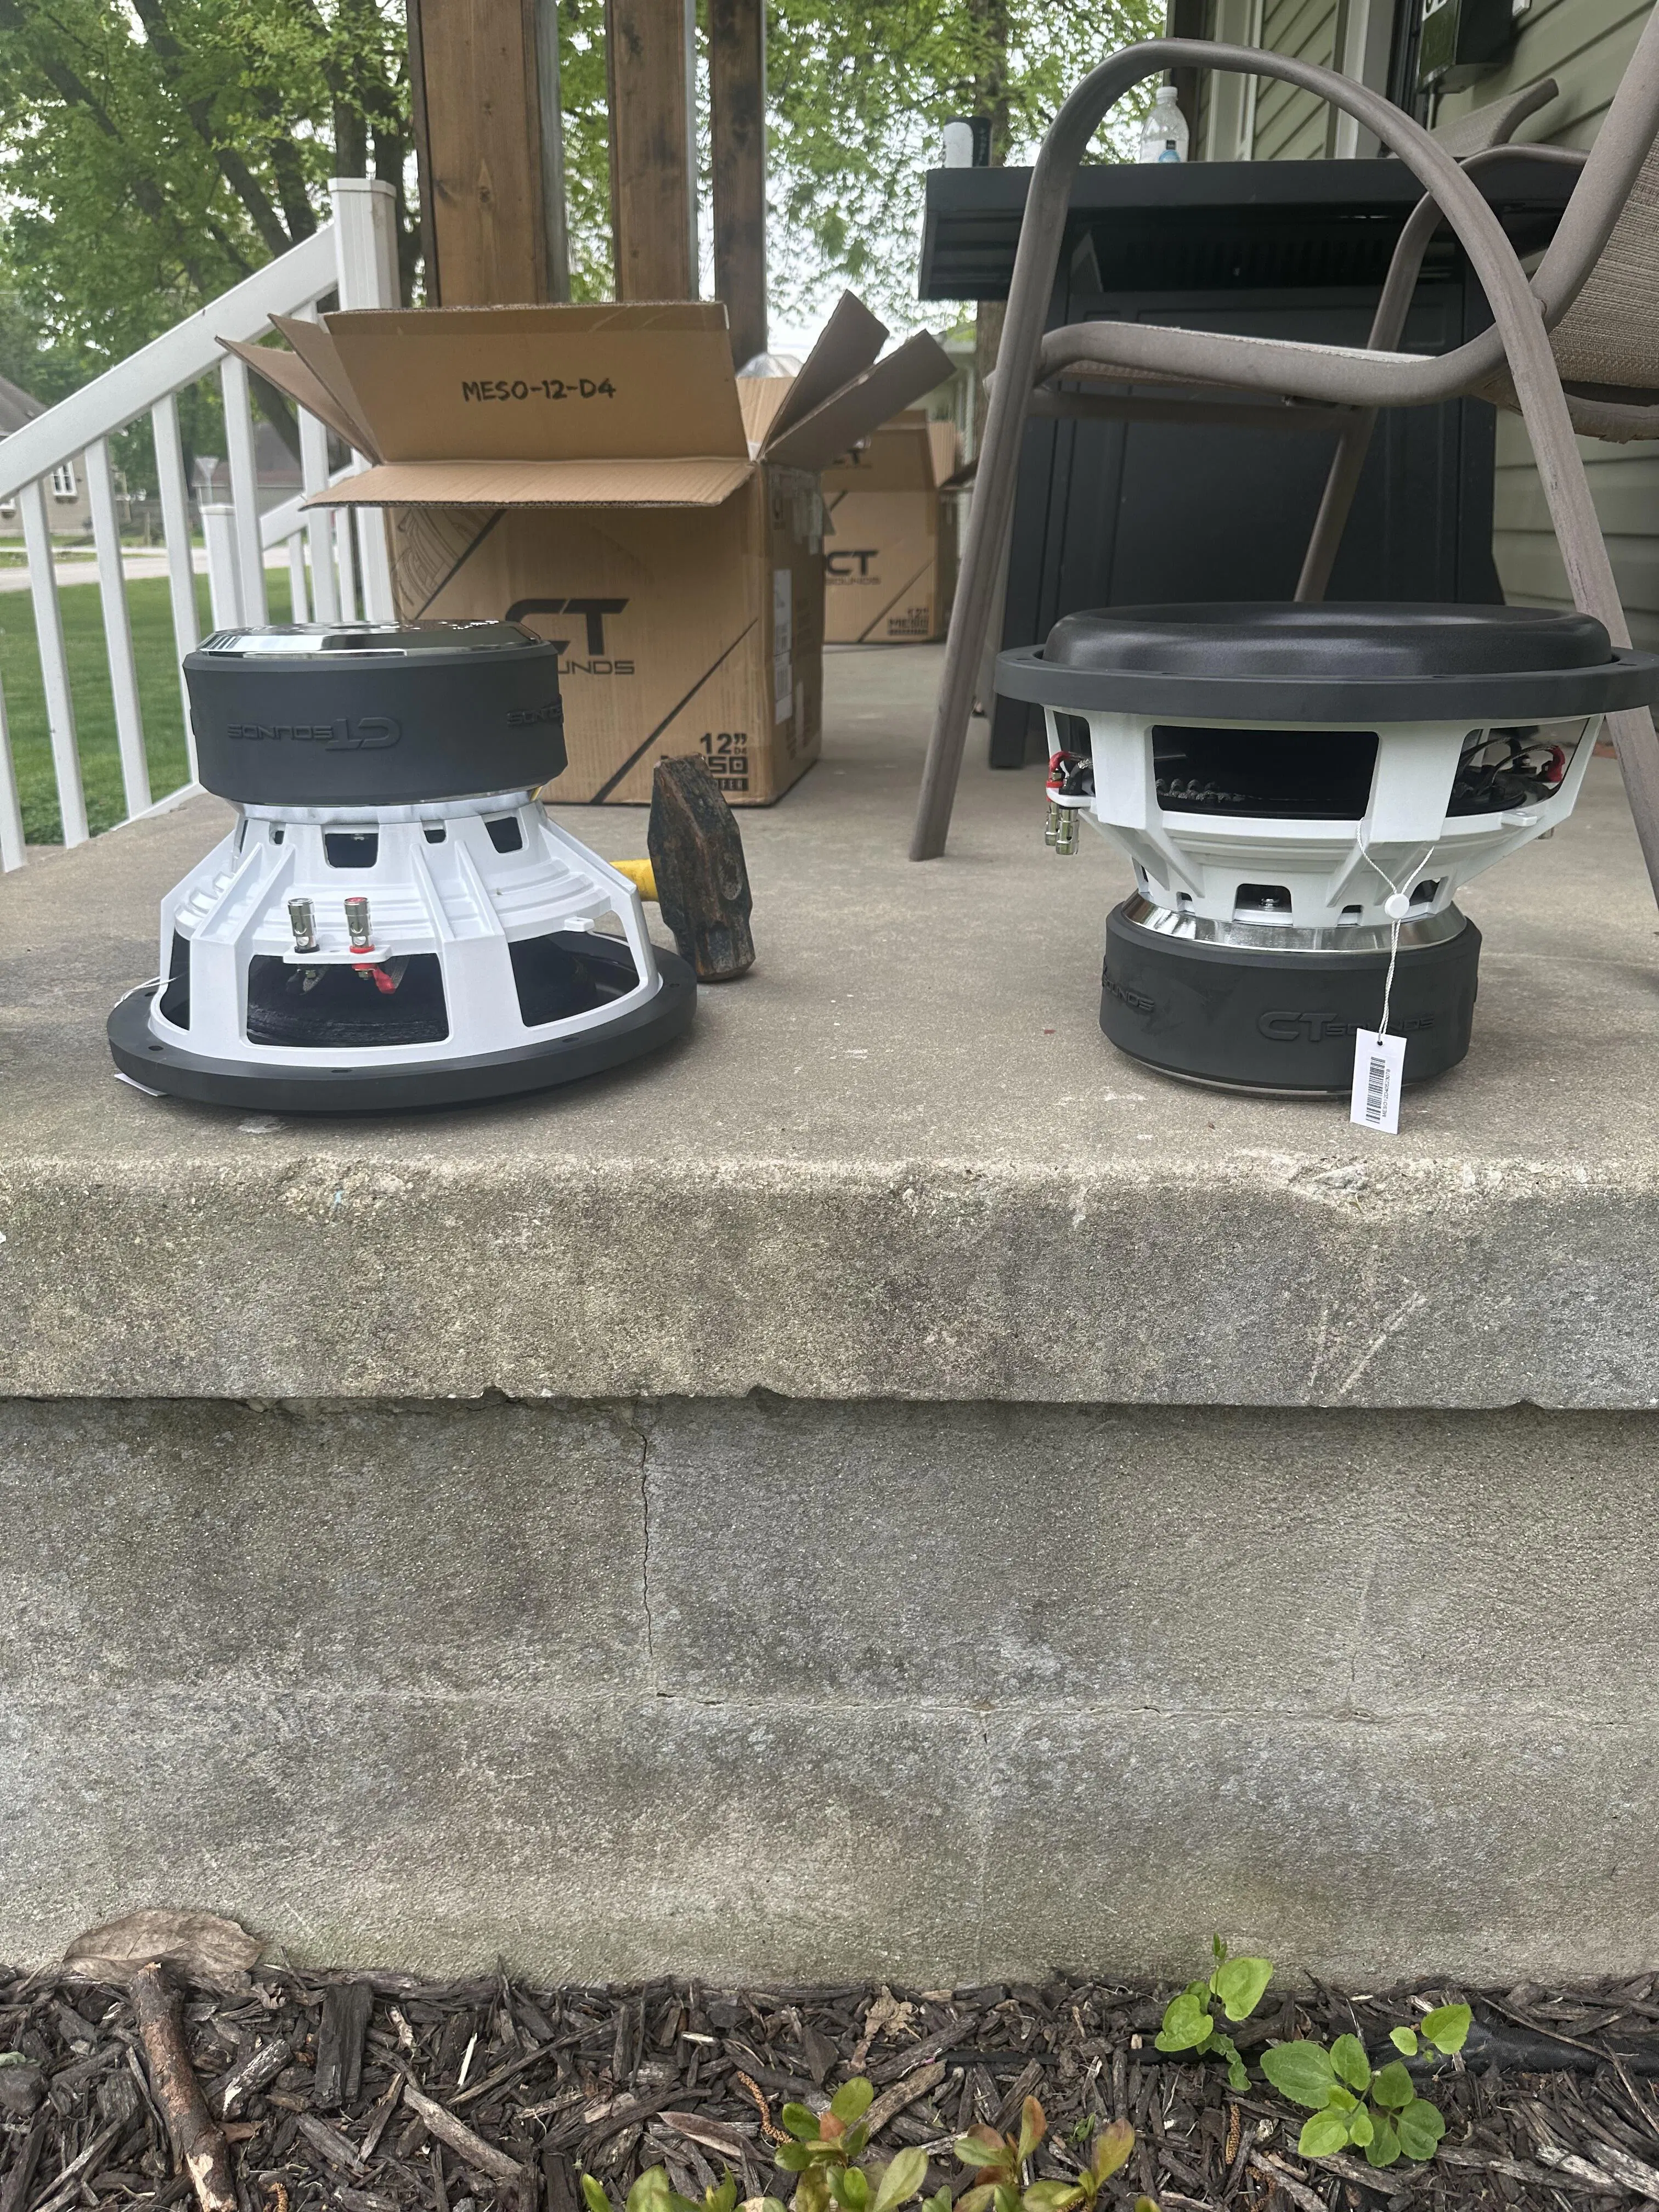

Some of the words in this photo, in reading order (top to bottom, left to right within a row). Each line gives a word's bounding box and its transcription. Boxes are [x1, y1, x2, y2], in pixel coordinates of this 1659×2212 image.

[461, 377, 616, 402] MESO-12-D4
[826, 550, 879, 576] CT
[557, 661, 635, 675] UNDS
[227, 724, 332, 739] SOUNDS
[325, 716, 402, 751] CT
[1259, 1011, 1337, 1042] CT
